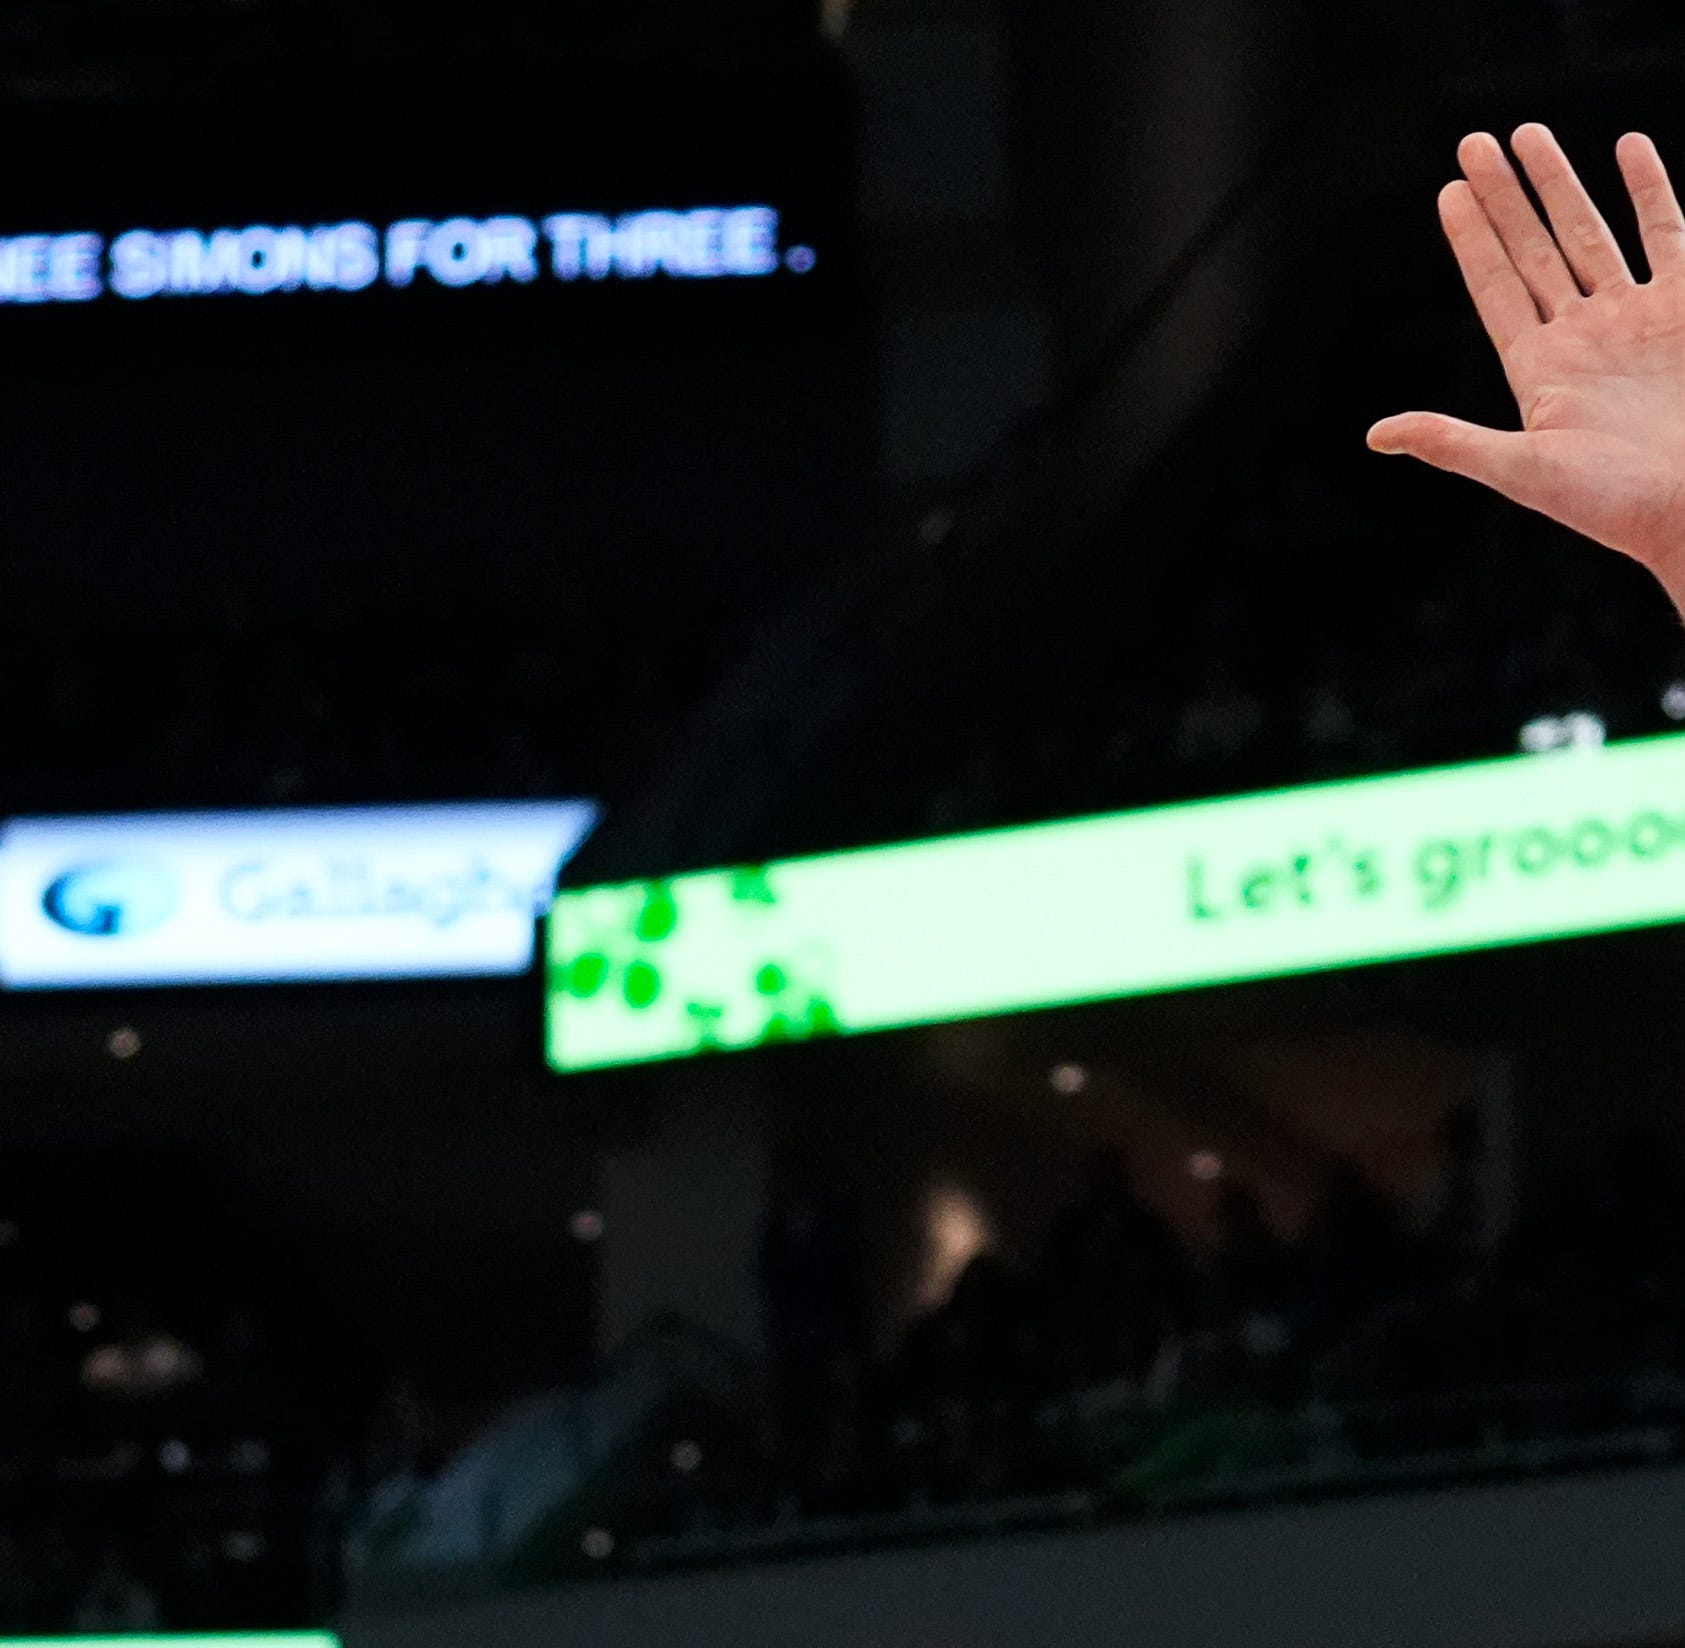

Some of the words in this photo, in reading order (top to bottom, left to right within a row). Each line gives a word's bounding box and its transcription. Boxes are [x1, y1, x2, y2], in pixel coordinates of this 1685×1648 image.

[110, 221, 380, 299] SIMONS
[385, 214, 538, 287] FOR
[1186, 829, 1383, 923] Let's
